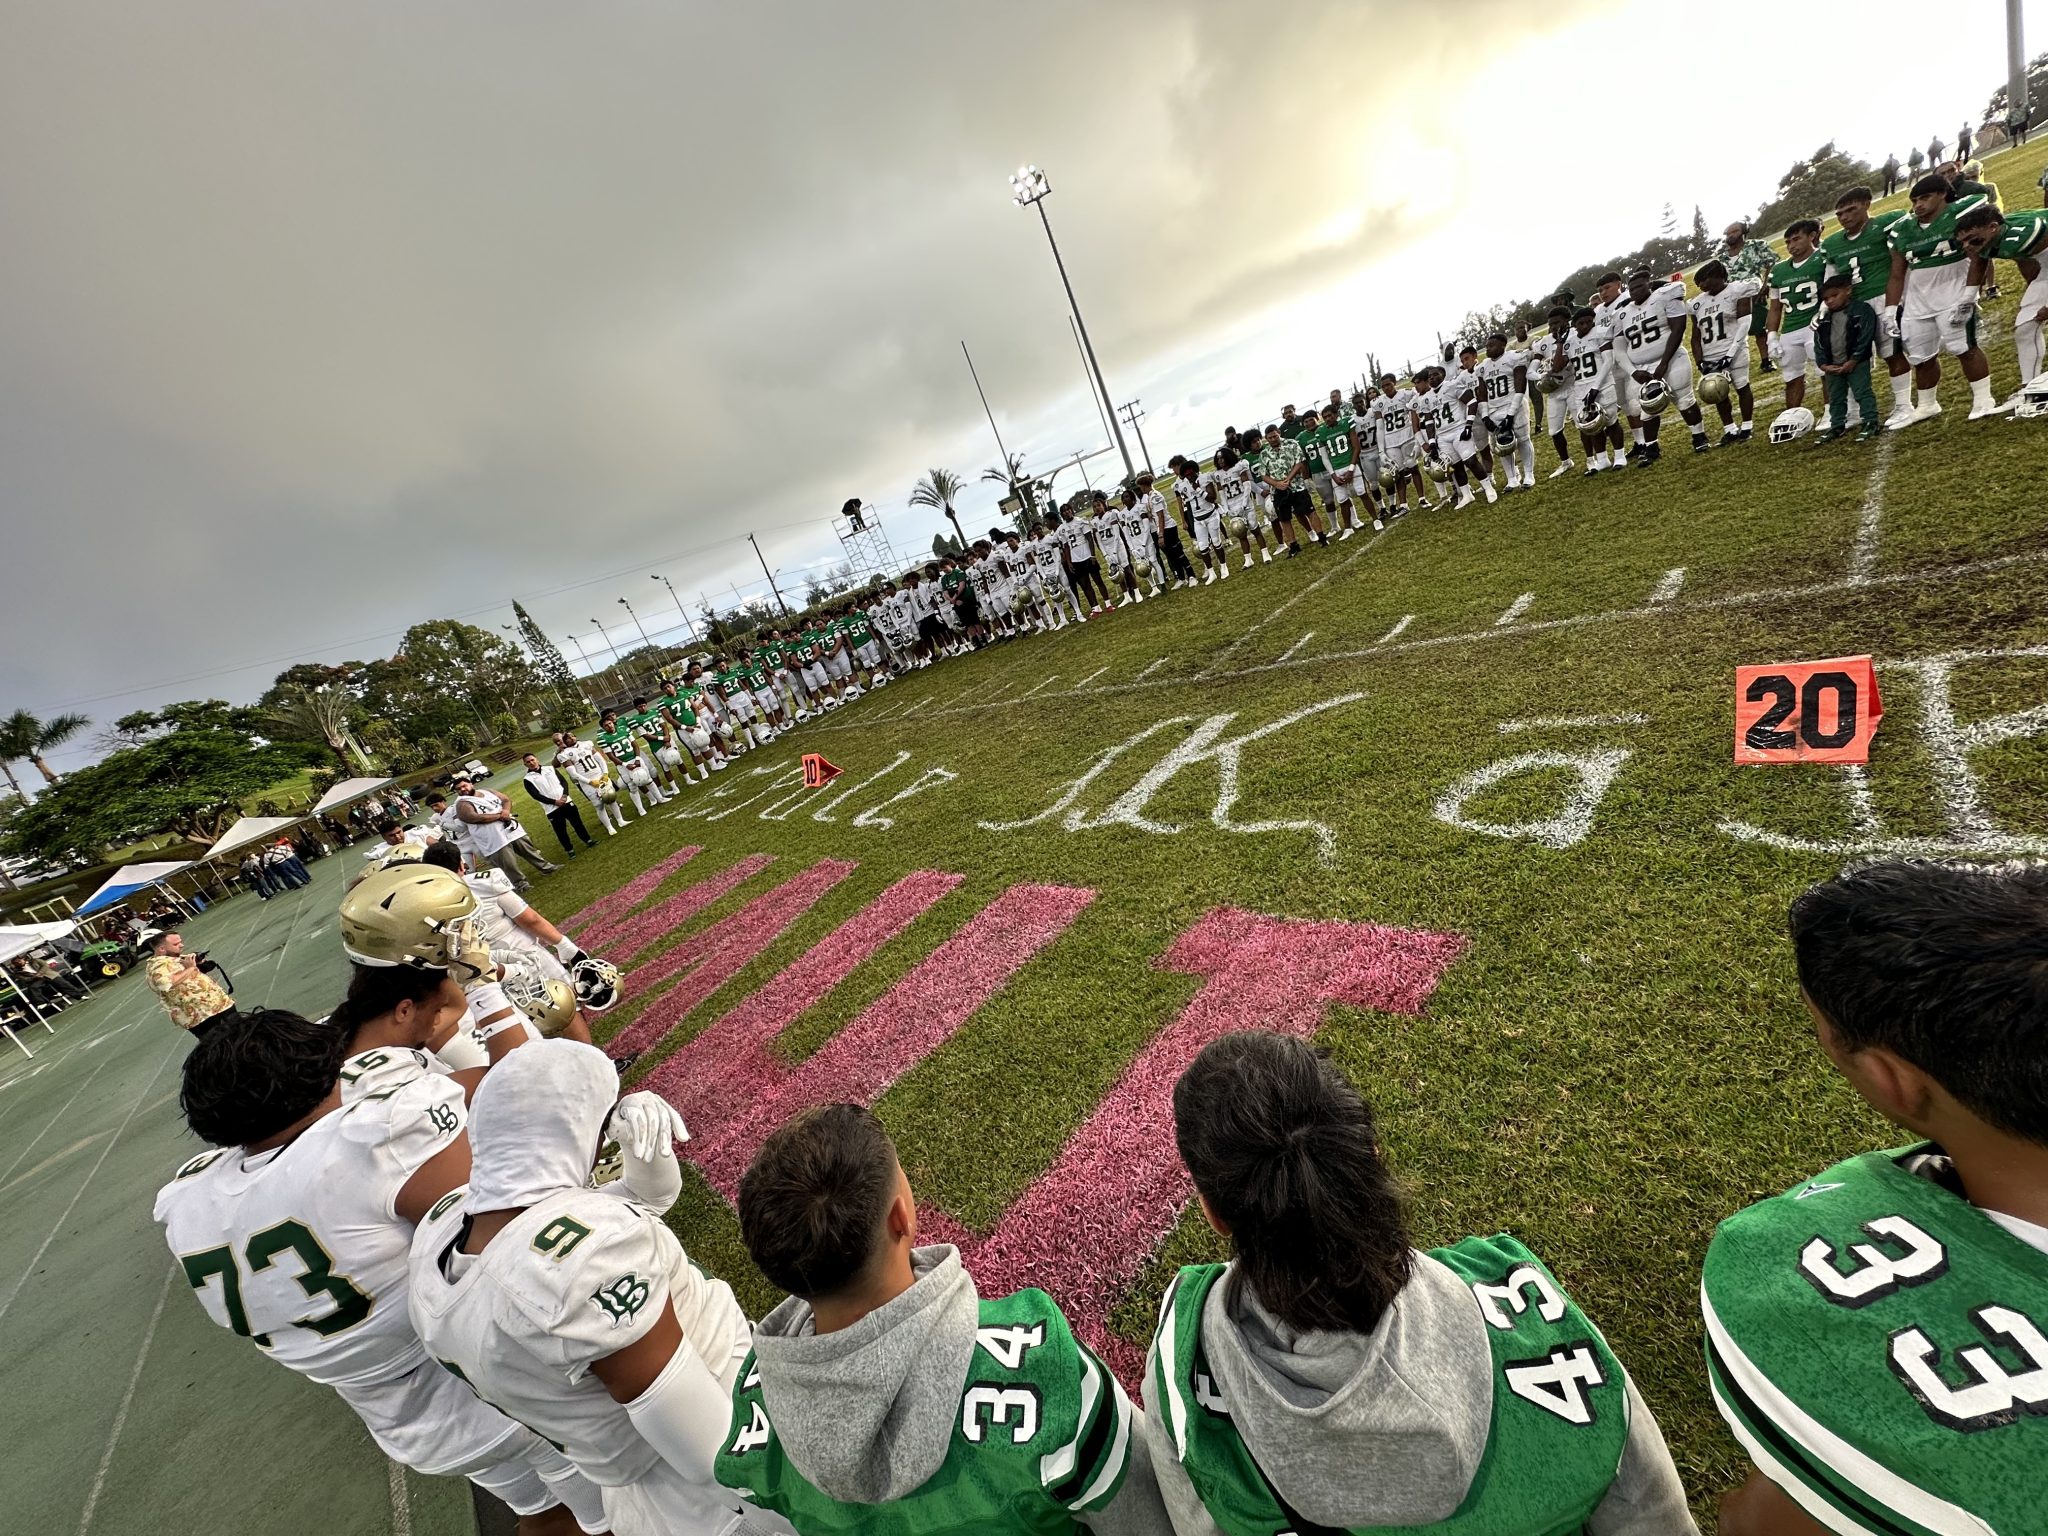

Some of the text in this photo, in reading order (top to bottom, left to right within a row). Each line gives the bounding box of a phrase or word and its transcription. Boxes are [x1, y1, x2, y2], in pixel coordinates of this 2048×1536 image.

[1778, 280, 1819, 313] 53
[1631, 311, 1647, 324] POLY
[1705, 303, 1720, 316] POLY
[1625, 315, 1661, 350] 65
[1699, 311, 1727, 344] 31
[1570, 351, 1598, 381] 29
[1384, 408, 1406, 432] 85
[1327, 434, 1349, 457] 10
[1127, 520, 1142, 537] 18
[849, 620, 866, 637] 56
[818, 635, 835, 650] 75
[765, 651, 782, 667] 13
[797, 646, 814, 662] 42
[723, 677, 740, 692] 24
[749, 672, 766, 688] 16
[670, 699, 692, 717] 74
[1745, 671, 1858, 750] 20
[643, 717, 663, 735] 32
[611, 738, 634, 757] 23
[578, 754, 597, 773] 10
[804, 758, 817, 786] 10
[529, 1212, 596, 1264] 9
[179, 1216, 377, 1350] 73
[1796, 1212, 2048, 1434] 33
[1471, 1261, 1607, 1427] 43
[961, 1317, 1047, 1445] 34
